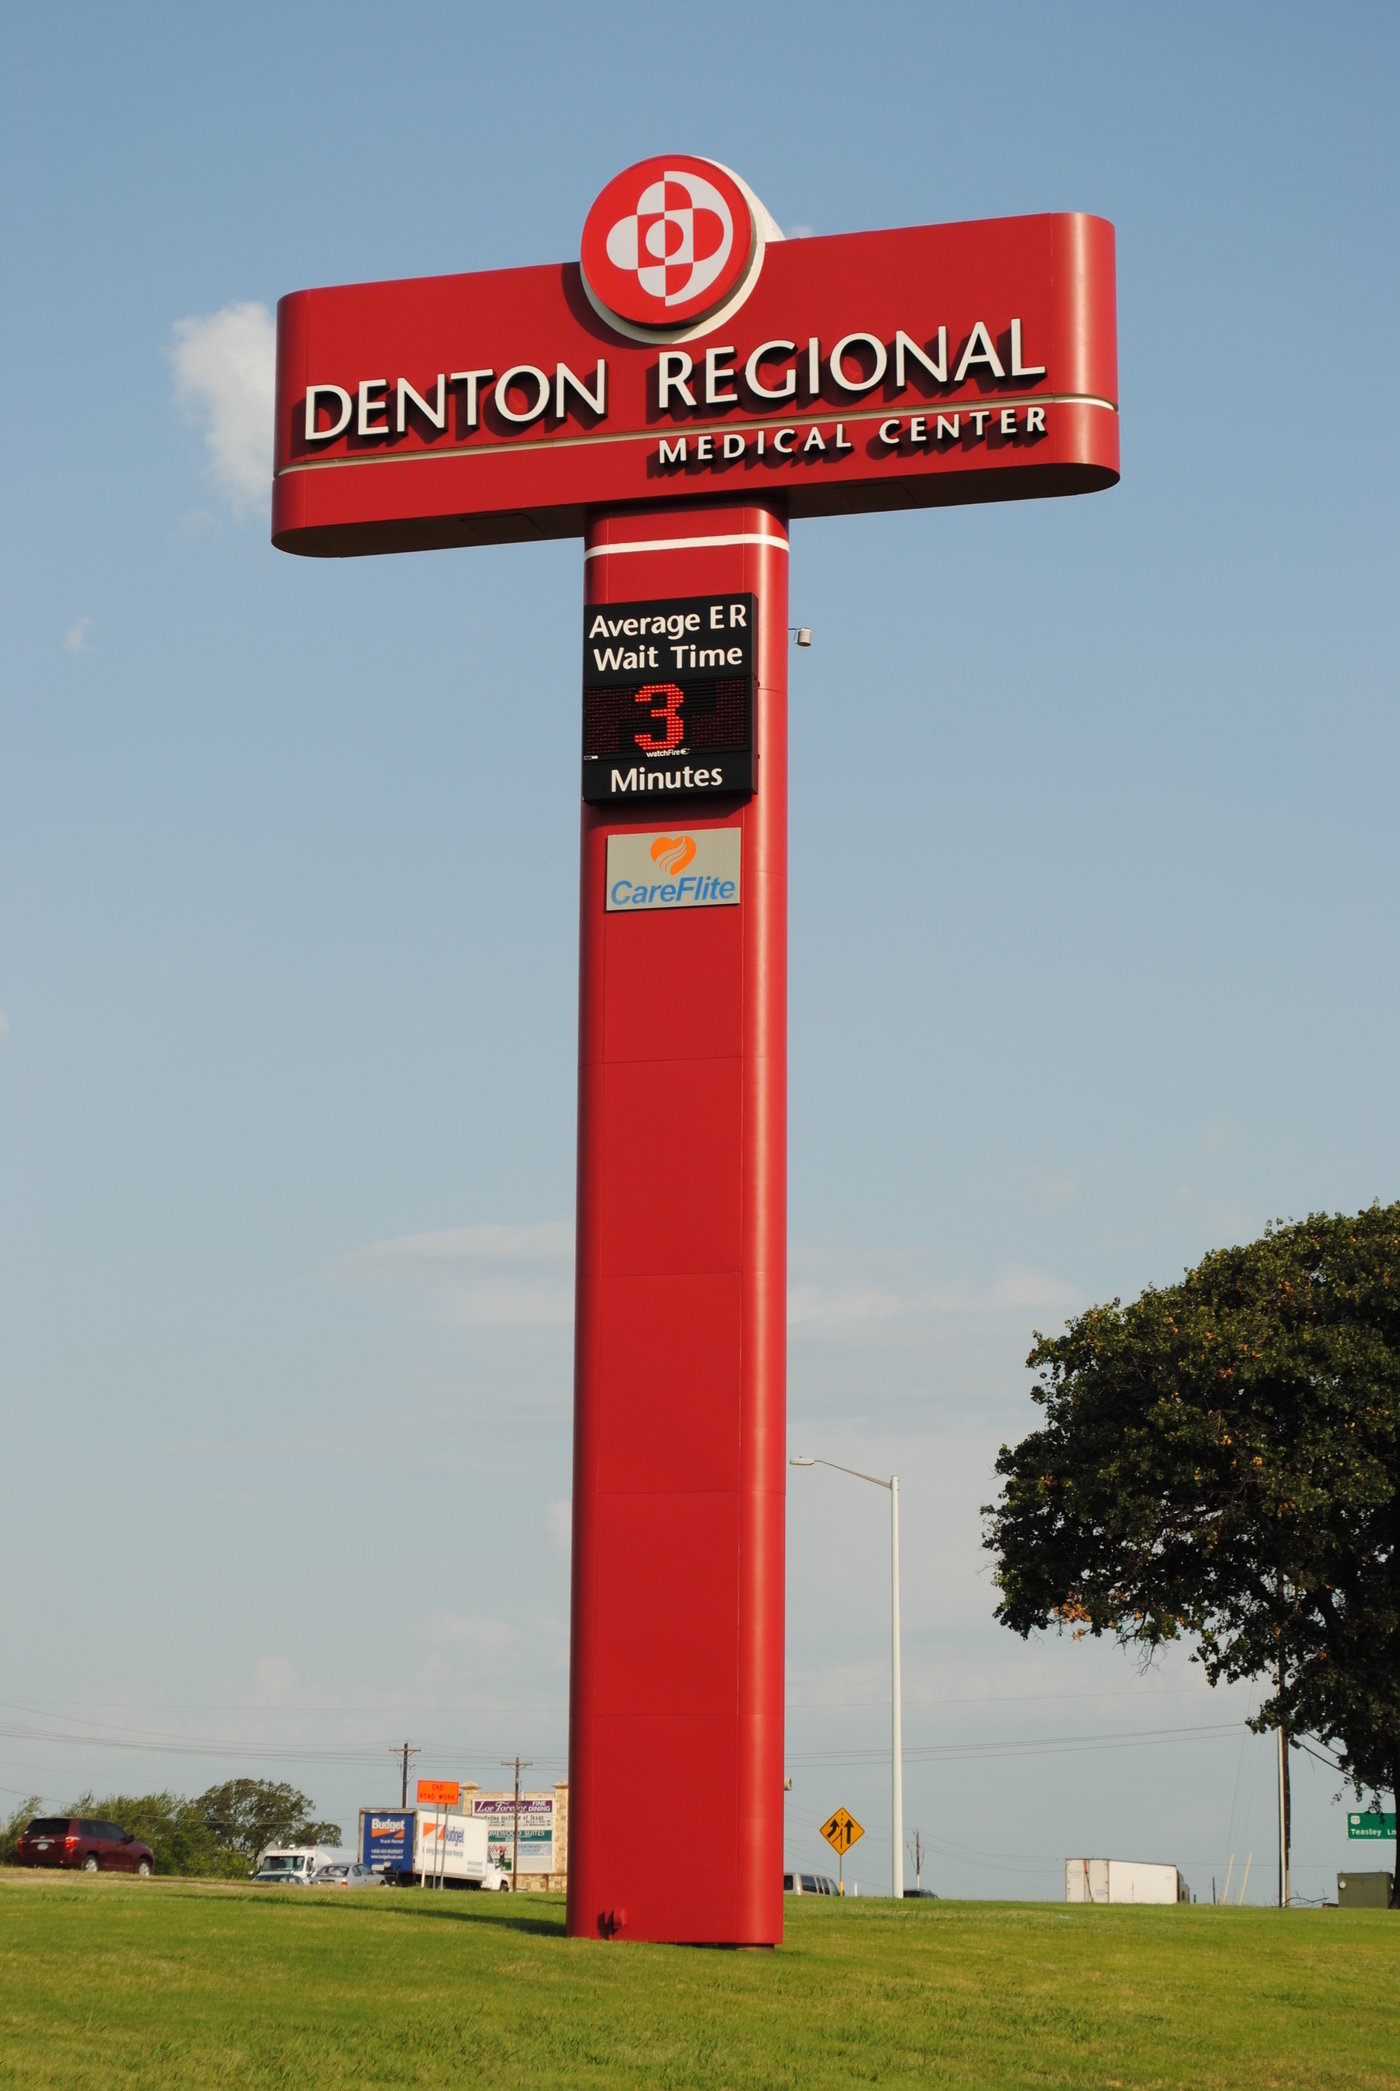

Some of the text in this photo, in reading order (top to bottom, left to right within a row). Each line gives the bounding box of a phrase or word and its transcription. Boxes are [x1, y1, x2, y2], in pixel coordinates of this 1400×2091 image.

[304, 317, 1046, 441] DENTON REGIONAL
[658, 406, 1047, 464] MEDICAL CENTER
[588, 604, 747, 641] Average ER
[593, 644, 743, 672] Wait Time
[634, 683, 684, 750] 3
[611, 766, 723, 793] Minutes
[611, 875, 736, 906] CareFlite
[419, 1792, 455, 1801] ROAD WORK
[432, 1783, 444, 1791] END
[372, 1818, 405, 1833] Budget
[443, 1825, 464, 1847] udget
[1351, 1829, 1382, 1837] Teasley
